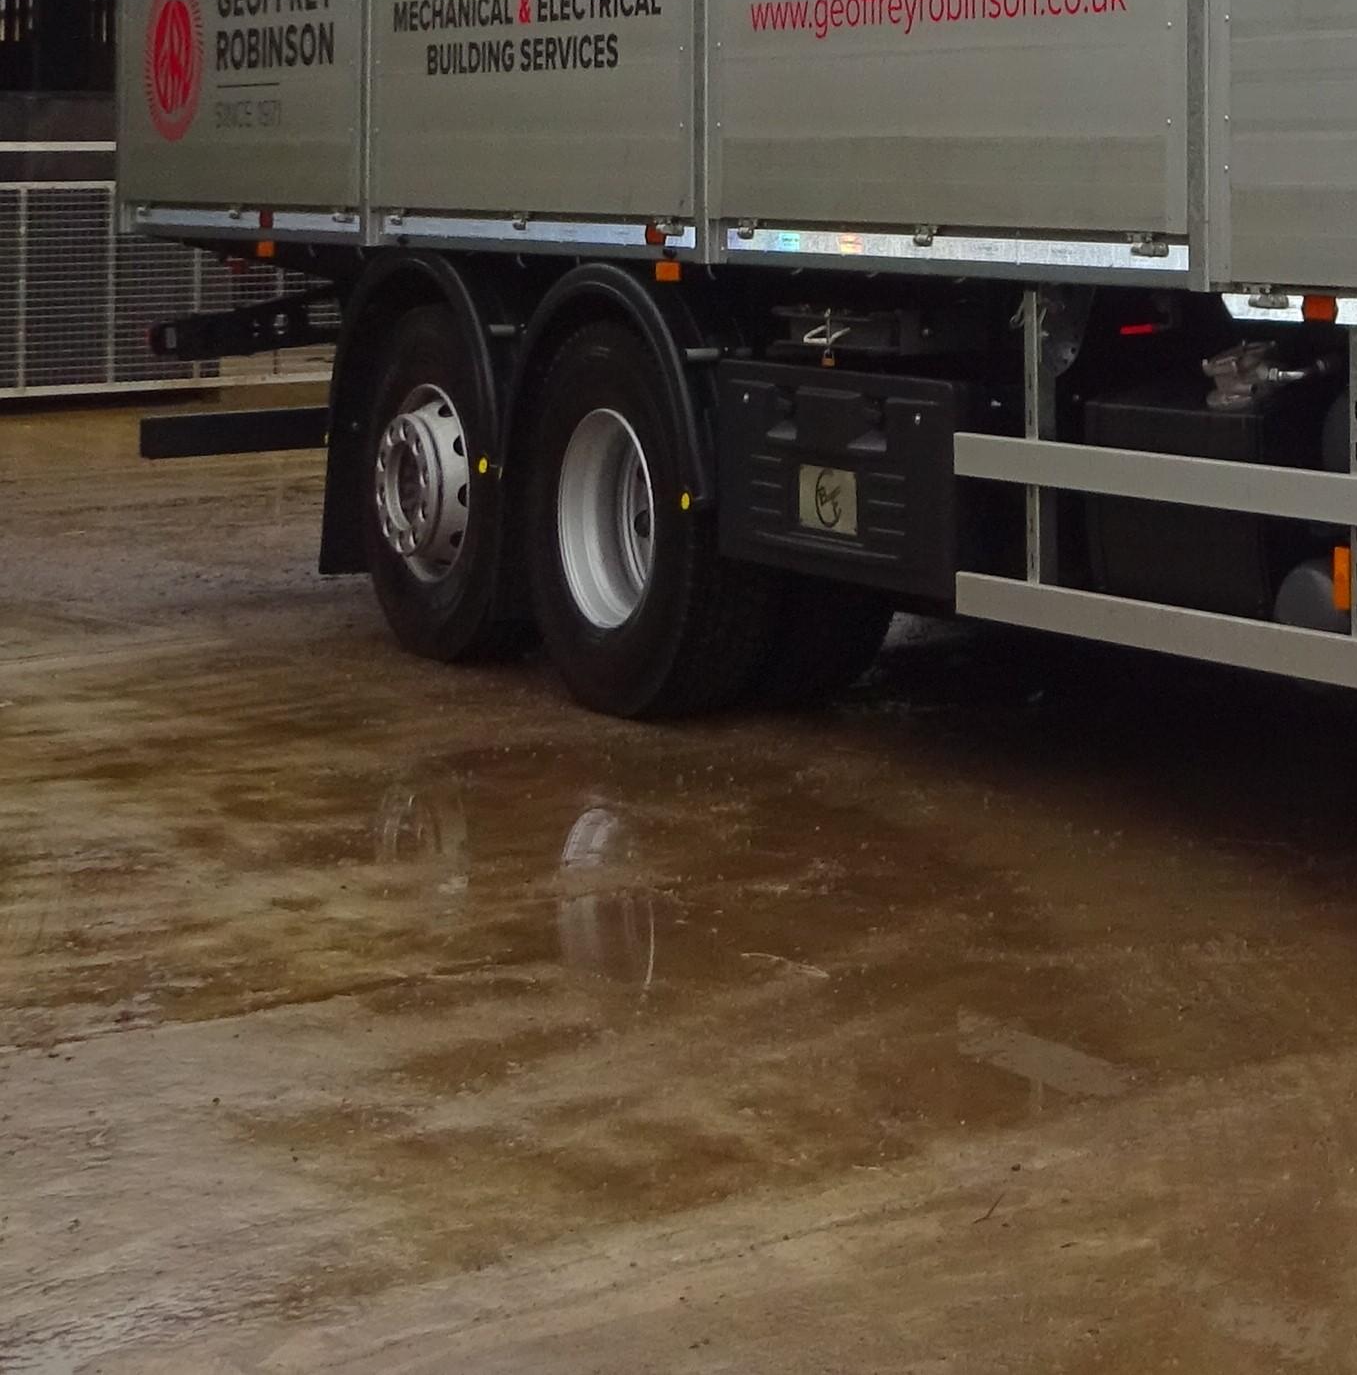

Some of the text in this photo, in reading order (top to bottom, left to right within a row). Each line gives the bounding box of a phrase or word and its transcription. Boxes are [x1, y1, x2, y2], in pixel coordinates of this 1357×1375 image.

[215, 21, 335, 71] ROBINSON
[426, 33, 619, 76] BUILDING SERVICES
